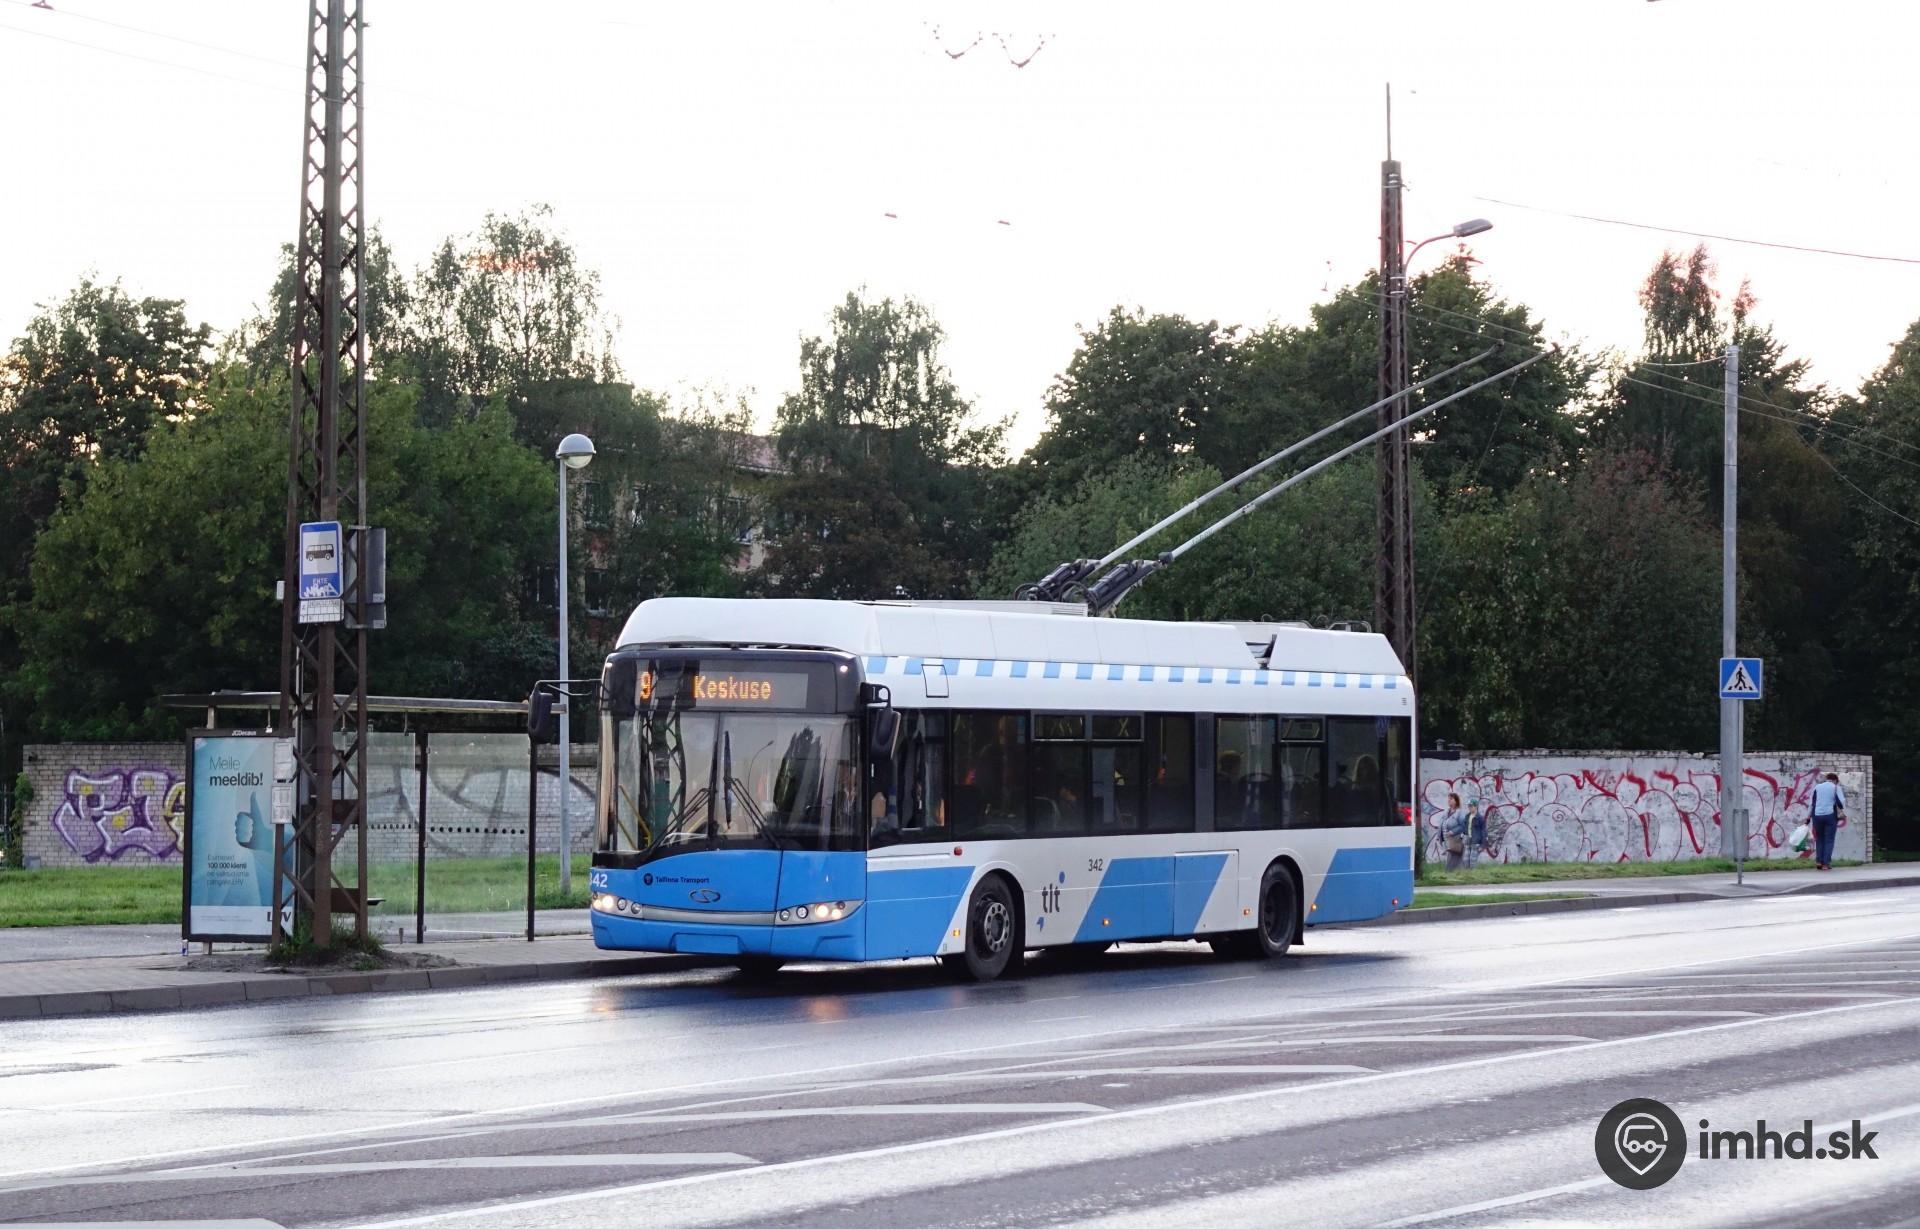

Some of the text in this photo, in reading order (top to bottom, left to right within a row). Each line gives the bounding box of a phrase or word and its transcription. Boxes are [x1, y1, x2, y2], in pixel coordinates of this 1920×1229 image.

[640, 671, 772, 699] 9 Keskuse
[210, 756, 240, 771] Meile
[209, 773, 263, 786] meeldib!
[1088, 858, 1104, 872] 342
[680, 877, 710, 885] Transport
[267, 911, 292, 922] LV
